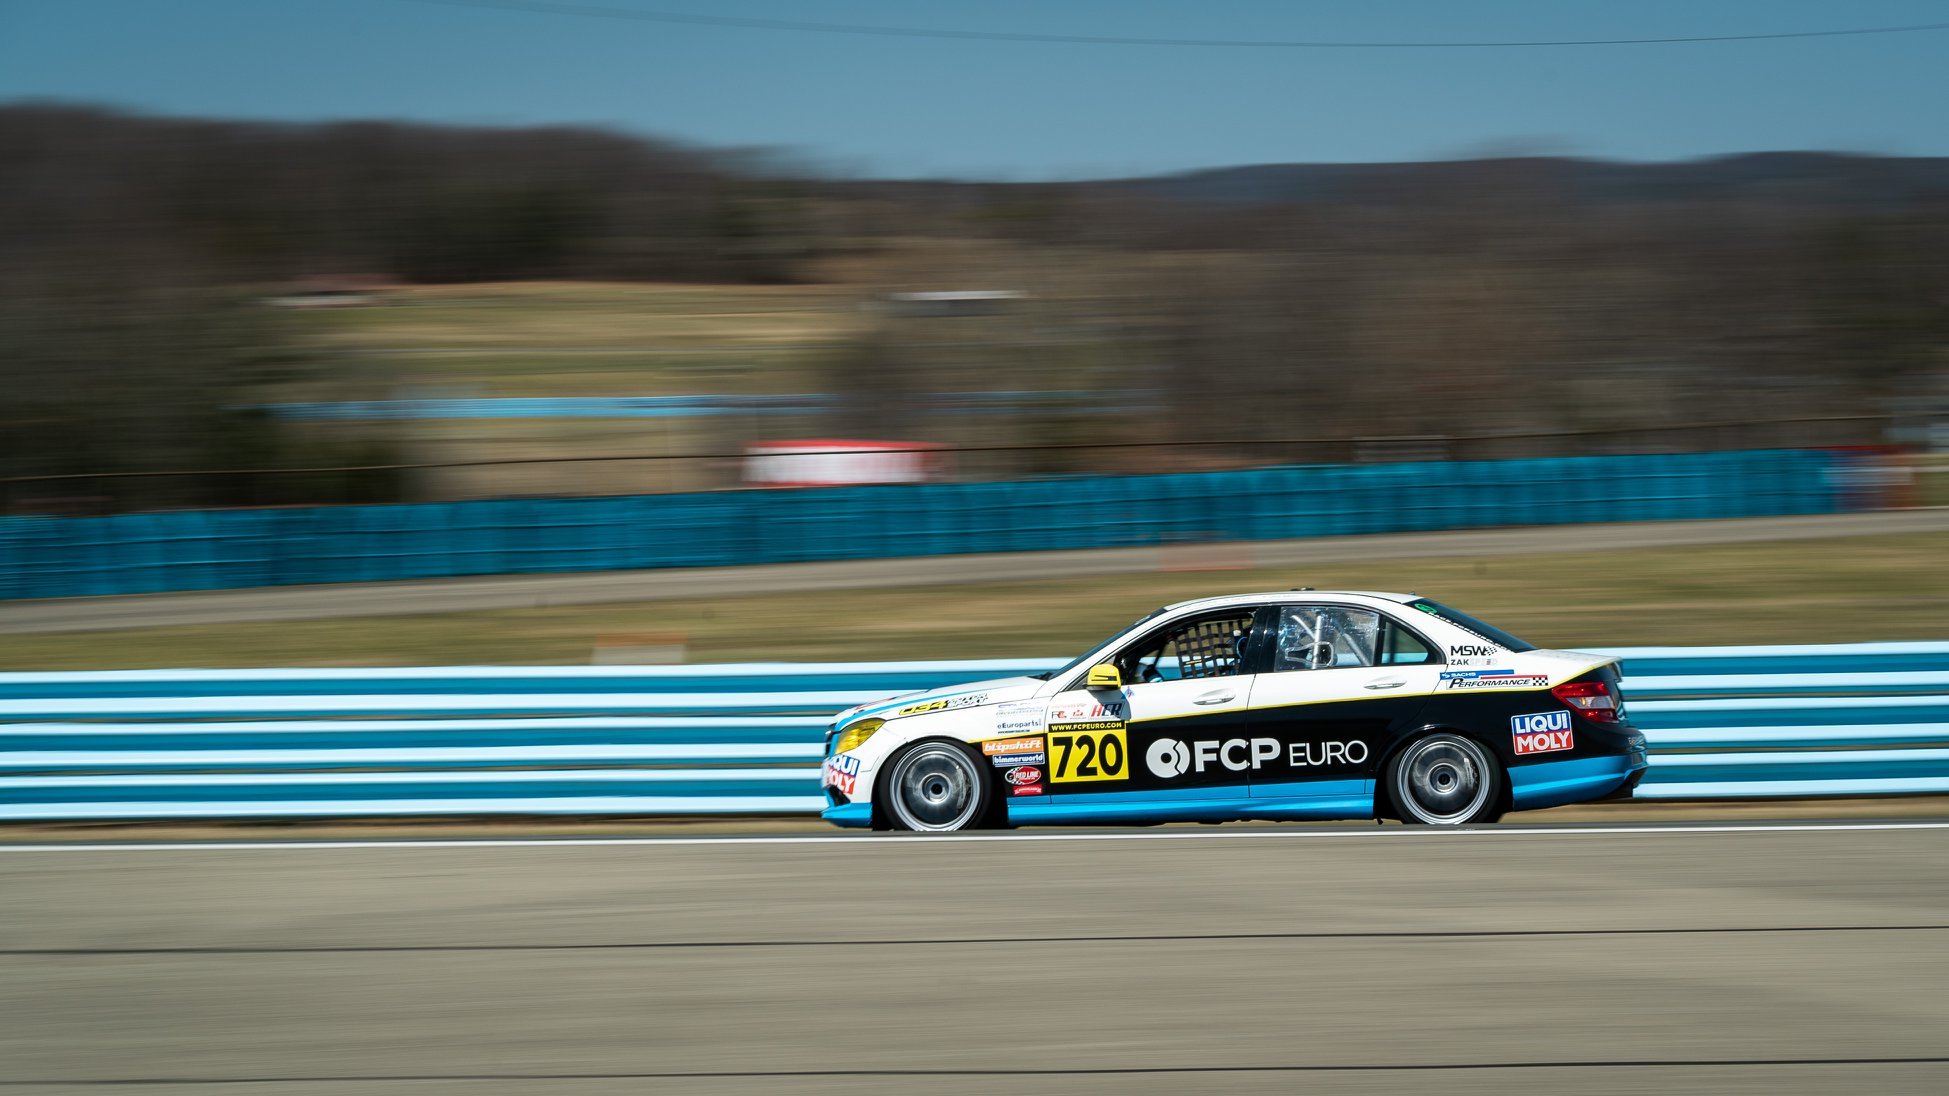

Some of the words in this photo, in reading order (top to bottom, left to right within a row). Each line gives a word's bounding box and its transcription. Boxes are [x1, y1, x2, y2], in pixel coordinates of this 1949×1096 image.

[1450, 646, 1486, 656] MSW
[1449, 678, 1531, 689] PERFORMANCE
[1051, 722, 1122, 731] WWW.FCPEURO.COM
[1514, 712, 1569, 734] LIQUI
[1516, 731, 1571, 752] MOLY
[994, 754, 1043, 764] bimmerworld
[1052, 733, 1124, 778] 720
[1194, 737, 1281, 773] FCP
[1289, 740, 1369, 767] EURO
